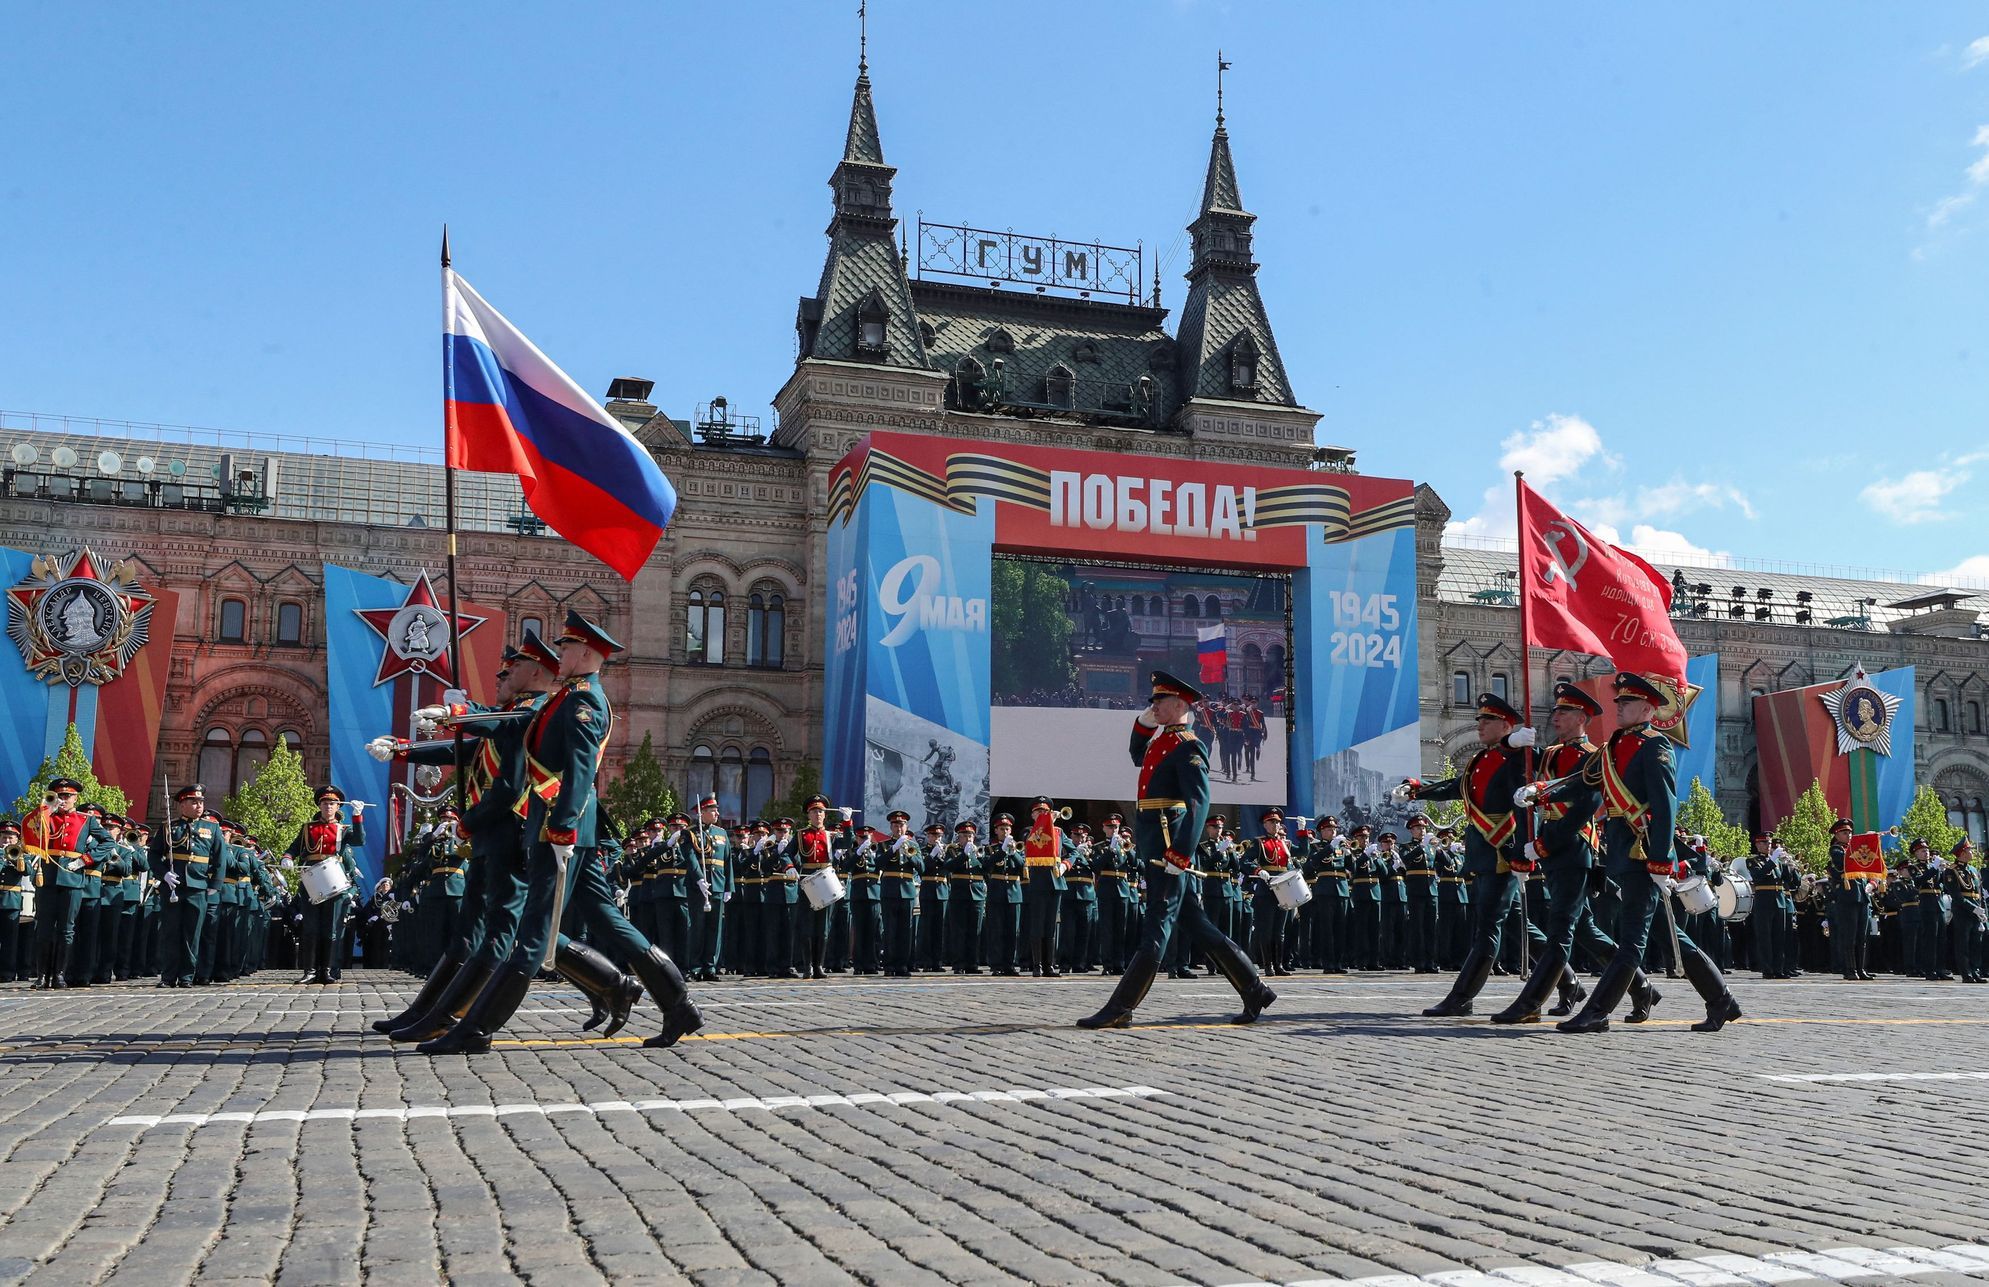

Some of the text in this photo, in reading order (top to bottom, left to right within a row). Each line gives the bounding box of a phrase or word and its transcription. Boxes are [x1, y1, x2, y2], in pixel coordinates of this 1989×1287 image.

[979, 239, 1086, 280] ГУМ
[1050, 470, 1257, 542] ПОБЕДА!
[45, 587, 72, 639] АЛЕКСАНДР
[836, 568, 858, 614] 1945
[879, 555, 986, 647] 9 МАЯ
[1329, 590, 1400, 631] 1945
[835, 610, 857, 656] 2024
[1330, 631, 1400, 669] 2024
